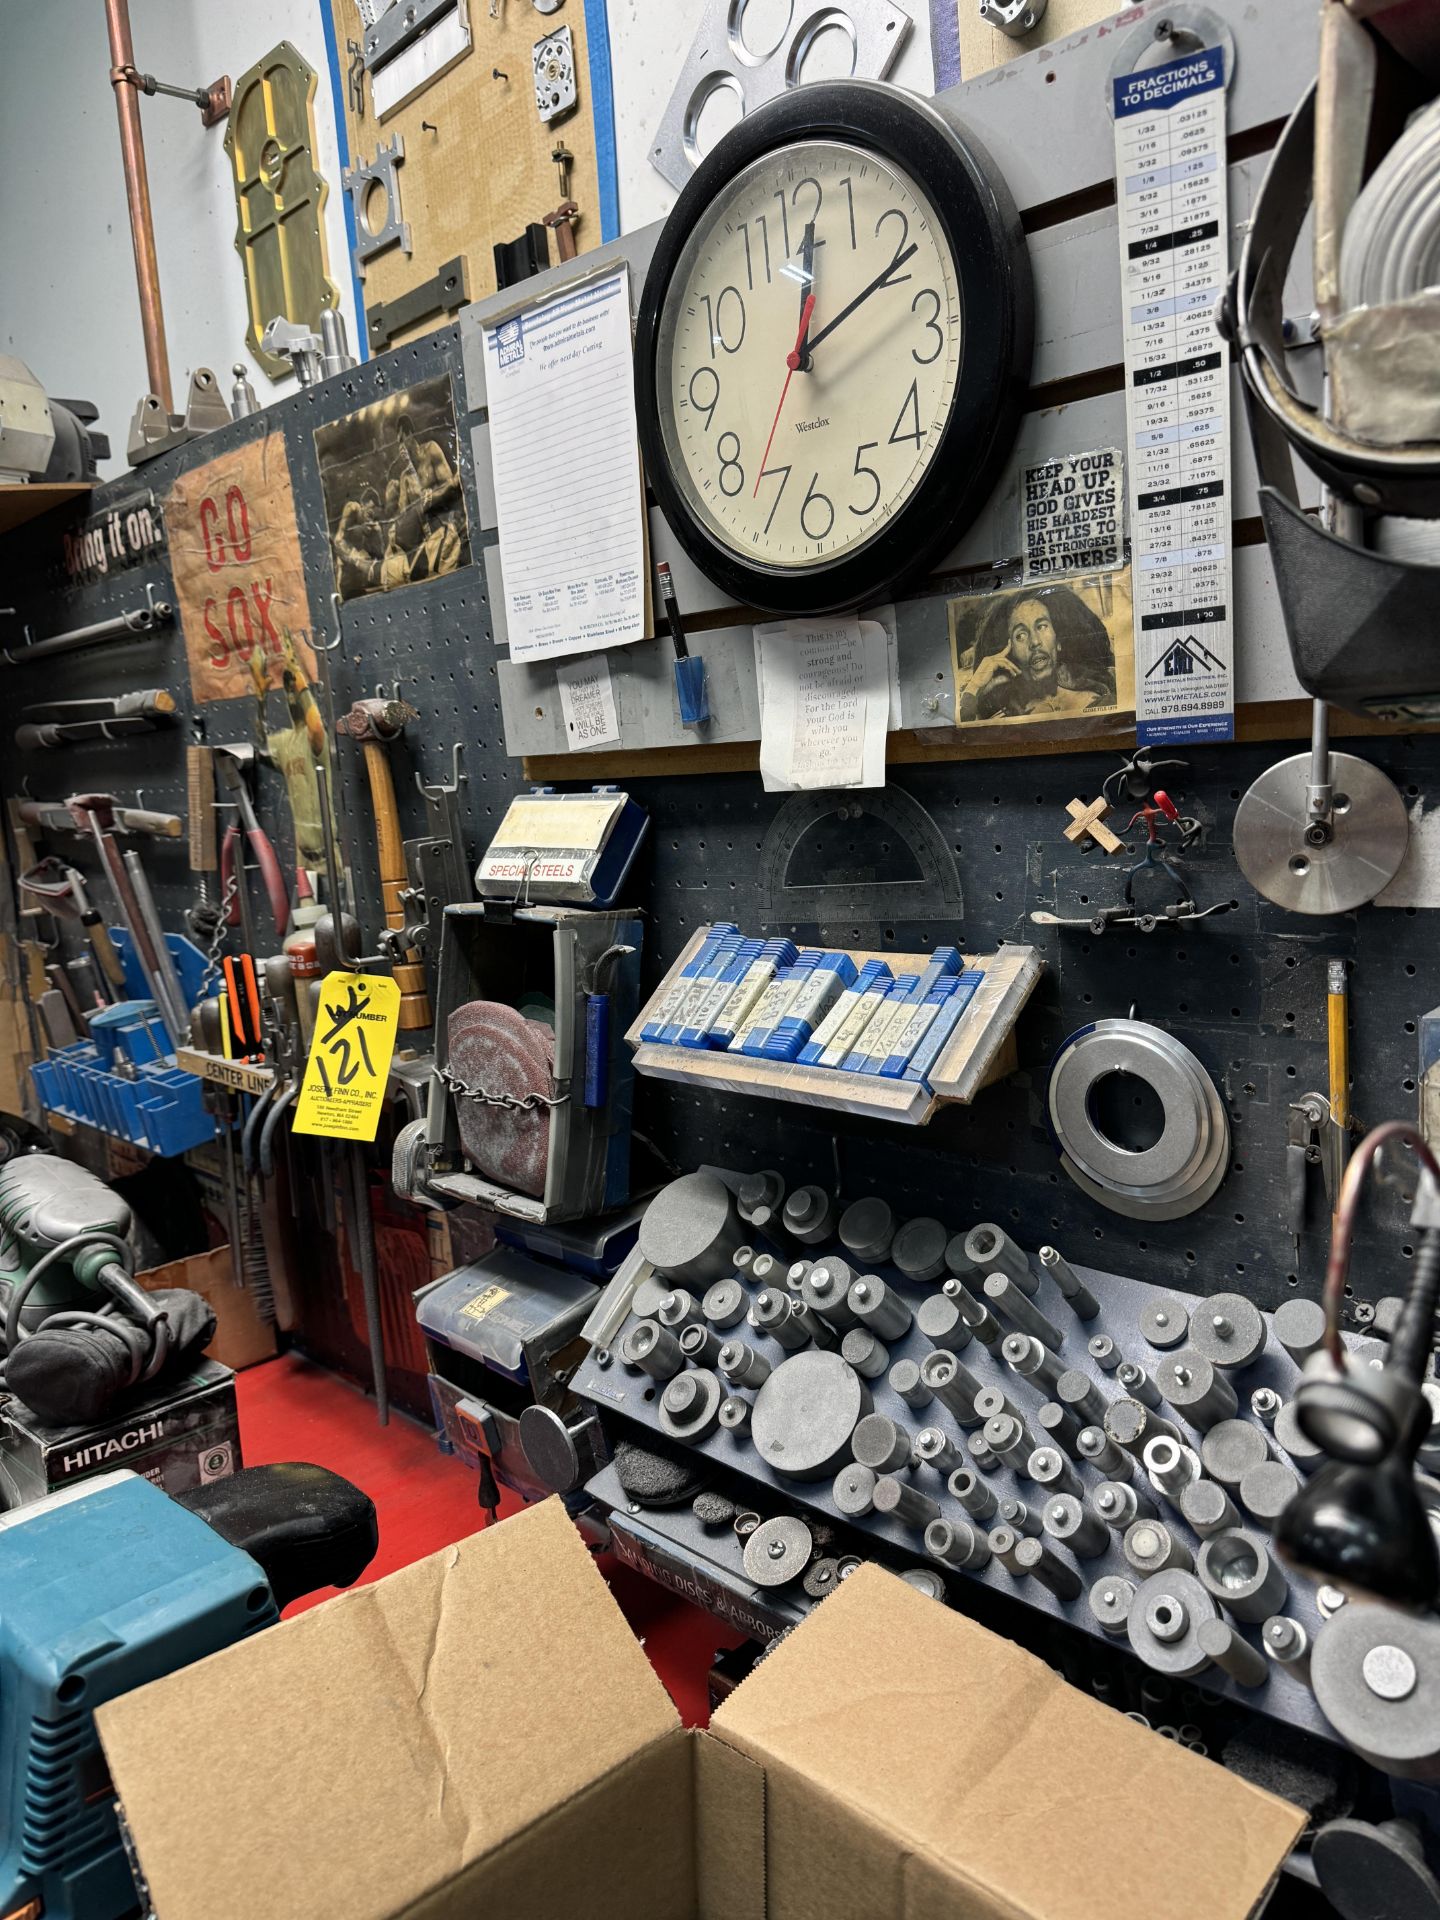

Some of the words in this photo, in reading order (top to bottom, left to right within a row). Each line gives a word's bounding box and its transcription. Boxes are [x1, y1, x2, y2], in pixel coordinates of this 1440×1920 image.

[1128, 60, 1208, 94] FRACTIONS
[1122, 94, 1140, 107] TO
[1144, 70, 1216, 101] DECIMALS
[1137, 124, 1156, 136] 1/32
[1138, 142, 1156, 153] 1/16
[1138, 158, 1157, 168] 3/32
[1142, 174, 1155, 185] 1/8
[1139, 192, 1158, 202] 5/32
[775, 176, 826, 260] 12
[840, 176, 858, 250] 1
[1140, 208, 1159, 218] 3/16
[1140, 224, 1160, 236] 7/32
[738, 215, 772, 290] 11
[876, 208, 912, 290] 2
[1144, 240, 1157, 251] 1/4
[1142, 257, 1160, 268] 9/32
[1142, 273, 1161, 283] 5/16
[1142, 288, 1163, 300] 11/32
[1146, 306, 1160, 315] 3/8
[701, 286, 746, 359] 10
[911, 288, 944, 364] 3
[1142, 321, 1166, 332] 13/32
[499, 339, 523, 356] ADMIRAL
[1145, 338, 1164, 348] 7/16
[499, 347, 524, 367] METALS
[1144, 353, 1166, 364] 15/32
[1150, 370, 1162, 379] 1/2
[1145, 384, 1168, 395] 17/32
[690, 366, 720, 432] 9
[1147, 400, 1166, 411] 9/16
[888, 378, 926, 450] 4
[1146, 416, 1169, 426] 19/32
[794, 416, 830, 434] Westclox
[1151, 432, 1164, 442] 5/8
[1146, 447, 1169, 458] 21/32
[716, 432, 744, 496] 8
[1025, 463, 1064, 484] KEEP
[1069, 453, 1114, 473] YOUR
[1147, 463, 1170, 473] 11/16
[848, 442, 882, 516] 5
[1025, 476, 1076, 502] HEAD
[1082, 470, 1115, 490] UP.
[1147, 478, 1170, 488] 23/32
[761, 464, 792, 534] 7
[1026, 500, 1058, 518] GOD
[1064, 488, 1116, 510] GIVES
[1152, 494, 1166, 503] 3/4
[800, 472, 835, 540] 6
[1027, 517, 1048, 532] HIS
[1052, 505, 1116, 527] HARDEST
[1148, 508, 1171, 519] 25/32
[107, 511, 126, 558] it
[126, 506, 162, 551] on.
[199, 484, 251, 574] GO
[1028, 522, 1091, 548] BATTLES
[1096, 519, 1116, 535] TO
[1149, 524, 1172, 534] 13/16
[1028, 546, 1046, 558] HIS
[1048, 534, 1116, 554] STRONGEST
[1149, 539, 1172, 550] 27/32
[1029, 546, 1118, 574] SOLDIERS
[1155, 556, 1168, 564] 7/8
[1150, 570, 1173, 580] 29/32
[1151, 585, 1173, 596] 15/16
[1151, 600, 1174, 610] 31/32
[204, 576, 284, 669] SOX
[807, 656, 834, 668] strong
[836, 651, 852, 662] and
[851, 662, 863, 671] Do
[1164, 644, 1194, 676] EMI
[568, 680, 583, 690] YOU
[584, 672, 600, 685] MAY
[570, 689, 600, 705] DREAMER
[1144, 690, 1227, 704] WWW.EVMETALS.COM
[805, 704, 819, 714] For
[821, 702, 836, 711] the
[838, 699, 858, 709] Lord
[1145, 708, 1159, 716] CALL
[1161, 700, 1225, 714] 978.694.8989
[576, 720, 594, 730] WILL
[594, 714, 606, 726] BE
[806, 716, 826, 727] your
[828, 712, 845, 722] God
[847, 712, 855, 721] is
[578, 728, 589, 740] AS
[589, 726, 608, 737] ONE
[811, 725, 830, 736] with
[832, 725, 848, 736] you
[800, 737, 840, 748] wherever
[842, 735, 858, 746] you
[488, 864, 529, 876] SPECIAL
[533, 864, 574, 877] STEELS
[348, 1009, 387, 1023] UMBER
[316, 1026, 377, 1097] 121
[206, 1062, 243, 1087] CENTER
[246, 1077, 272, 1094] LINE
[334, 1087, 349, 1097] FINN
[364, 1090, 378, 1100] INC.
[63, 1421, 164, 1472] HITACHI
[620, 1546, 672, 1584] SANDING
[674, 1577, 713, 1605] DISCS
[715, 1597, 727, 1613] &
